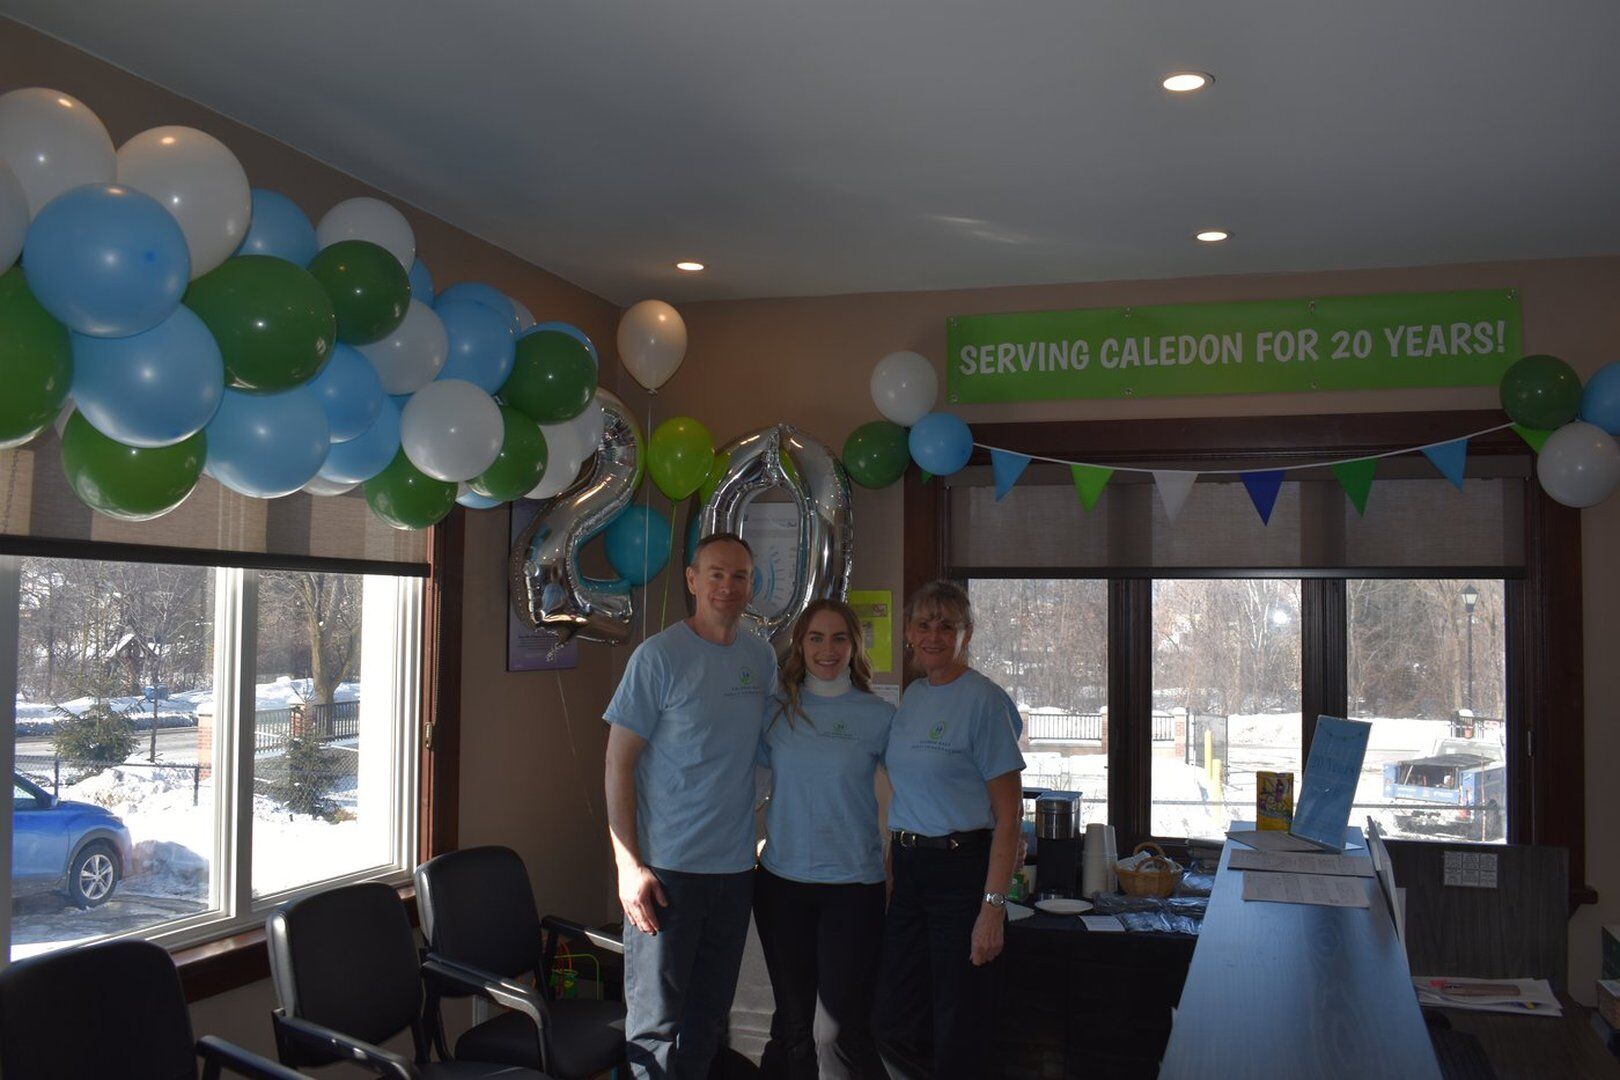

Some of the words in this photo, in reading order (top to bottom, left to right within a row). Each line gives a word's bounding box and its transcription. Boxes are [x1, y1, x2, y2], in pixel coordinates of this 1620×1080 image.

[959, 339, 1090, 376] SERVING
[1100, 332, 1243, 369] CALEDON
[1256, 328, 1320, 363] FOR
[1330, 329, 1373, 360] 20
[1384, 320, 1506, 358] YEARS!
